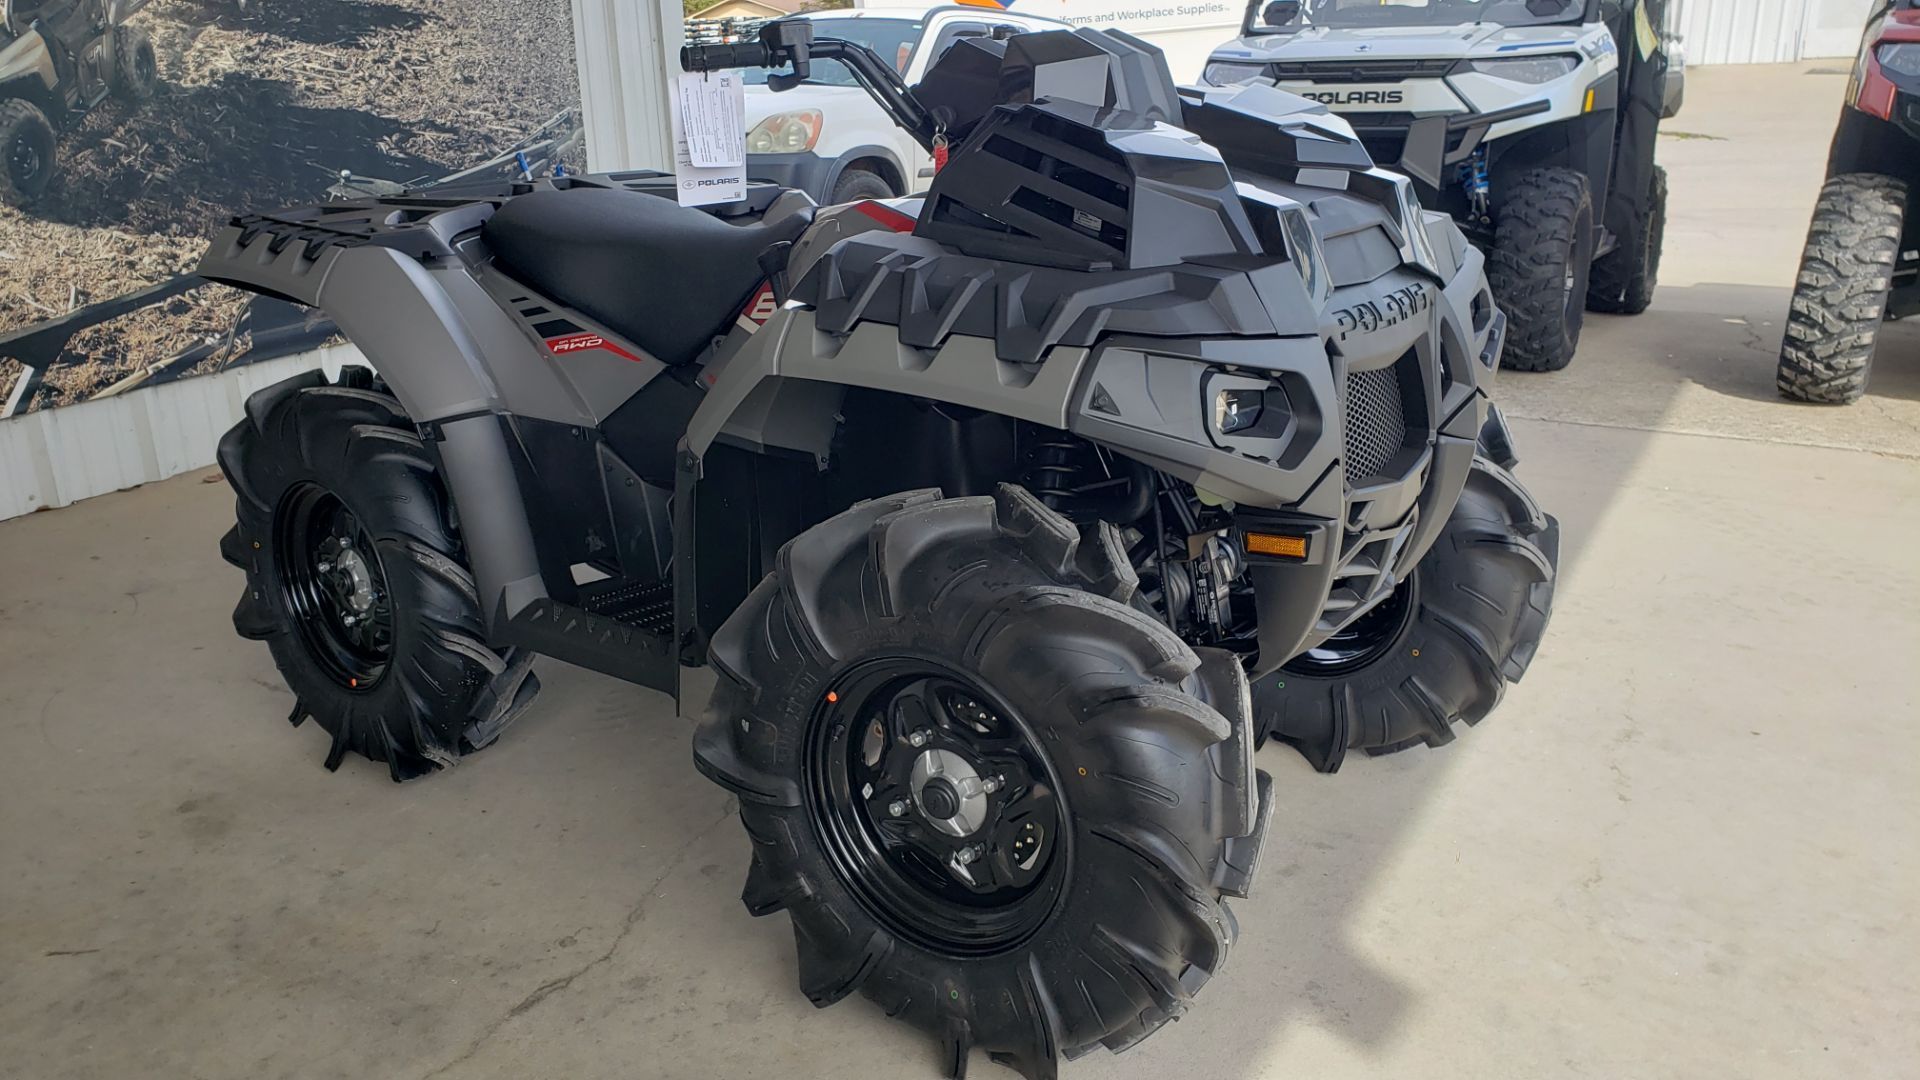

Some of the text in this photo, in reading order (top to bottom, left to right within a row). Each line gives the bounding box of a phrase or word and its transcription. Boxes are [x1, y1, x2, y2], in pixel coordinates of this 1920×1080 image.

[1057, 3, 1224, 25] iforms and Workplace Supplies
[1302, 90, 1403, 105] POLARIS
[697, 177, 740, 188] POLARIS
[1331, 282, 1428, 341] POLARIS
[553, 338, 603, 352] AWD
